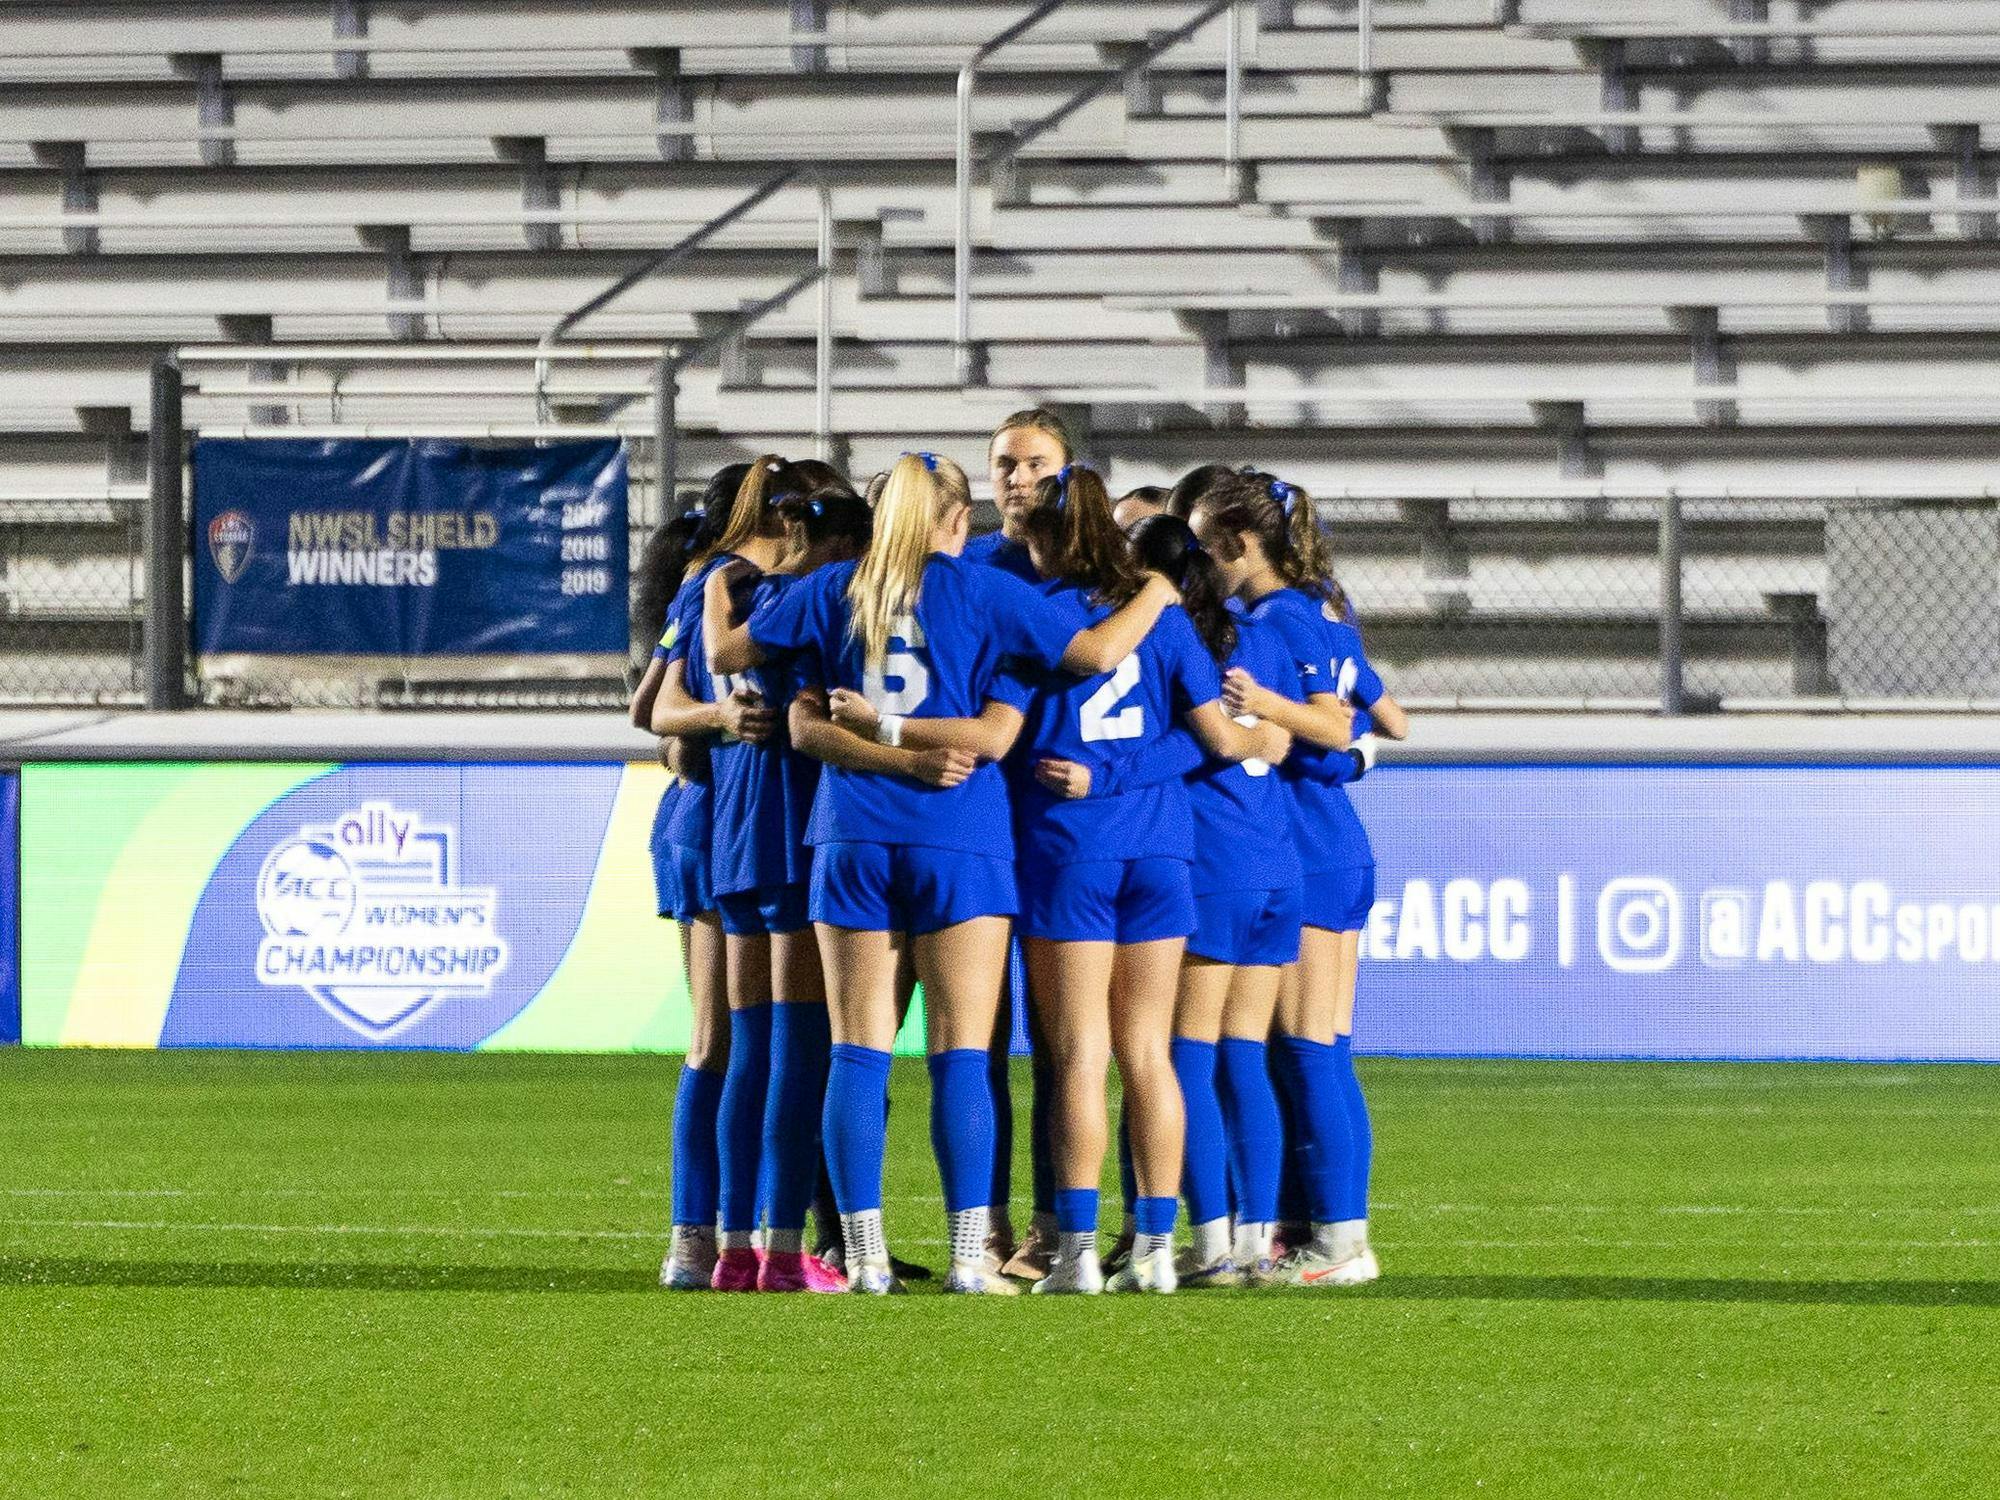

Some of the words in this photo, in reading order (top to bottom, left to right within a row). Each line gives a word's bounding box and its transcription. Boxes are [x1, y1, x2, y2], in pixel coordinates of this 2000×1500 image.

[288, 513, 379, 550] NWSL
[387, 513, 498, 549] SHIELD
[288, 551, 437, 586] WINNERS
[863, 617, 928, 716] 6
[1080, 651, 1144, 742] 2
[341, 810, 410, 857] ally
[365, 904, 486, 927] WOMEN'S
[263, 944, 501, 977] CHAMPIONSHIP
